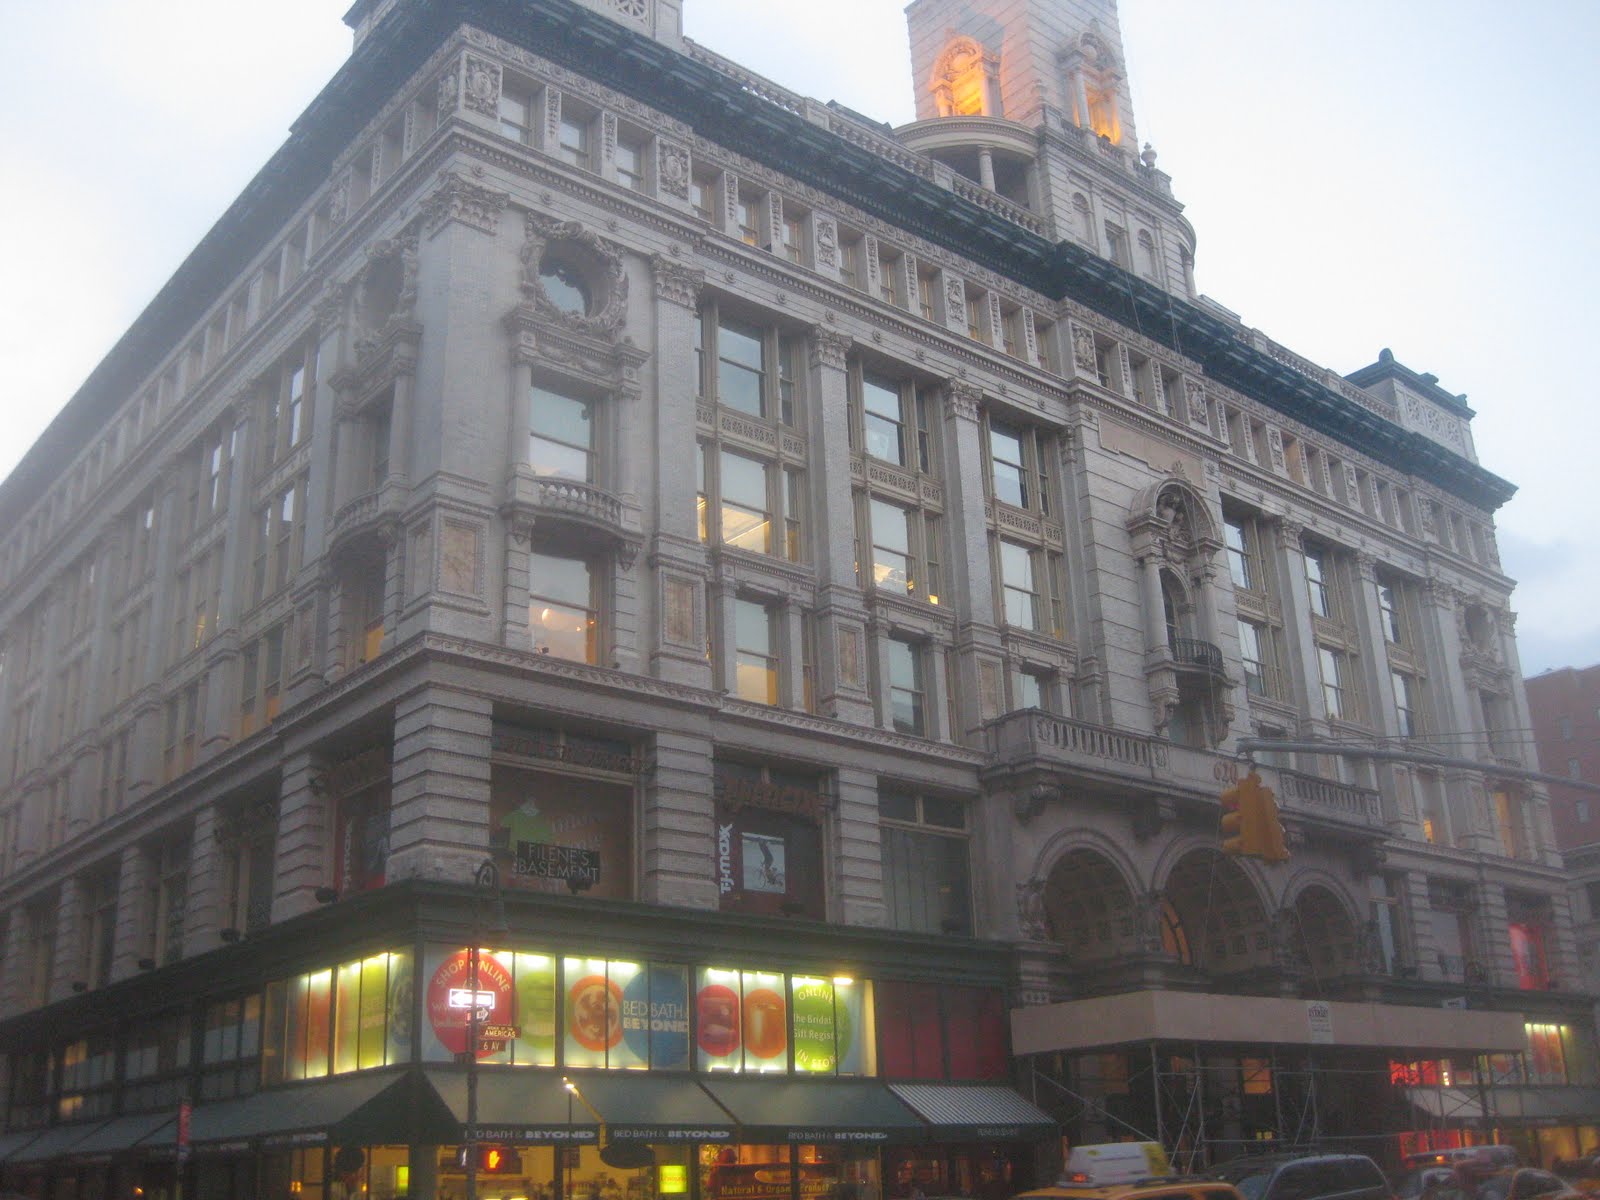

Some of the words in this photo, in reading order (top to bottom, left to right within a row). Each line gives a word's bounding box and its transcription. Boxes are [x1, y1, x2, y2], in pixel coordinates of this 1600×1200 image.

[528, 844, 589, 866] FILENE'S
[518, 861, 599, 881] BASEMENT
[437, 960, 465, 986] SHOP
[469, 960, 510, 993] NLINE
[623, 1001, 648, 1016] BED
[650, 1002, 682, 1018] BATH
[484, 1029, 516, 1038] AMERICAS
[483, 1041, 489, 1050] 6
[491, 1041, 500, 1050] AV
[811, 1054, 839, 1068] STOR
[525, 1130, 595, 1139] BEYOND
[614, 1130, 632, 1138] BED
[633, 1130, 657, 1138] BATH
[668, 1130, 730, 1138] BEYOND
[834, 1132, 887, 1140] BEYOND
[721, 1184, 754, 1195] Natural
